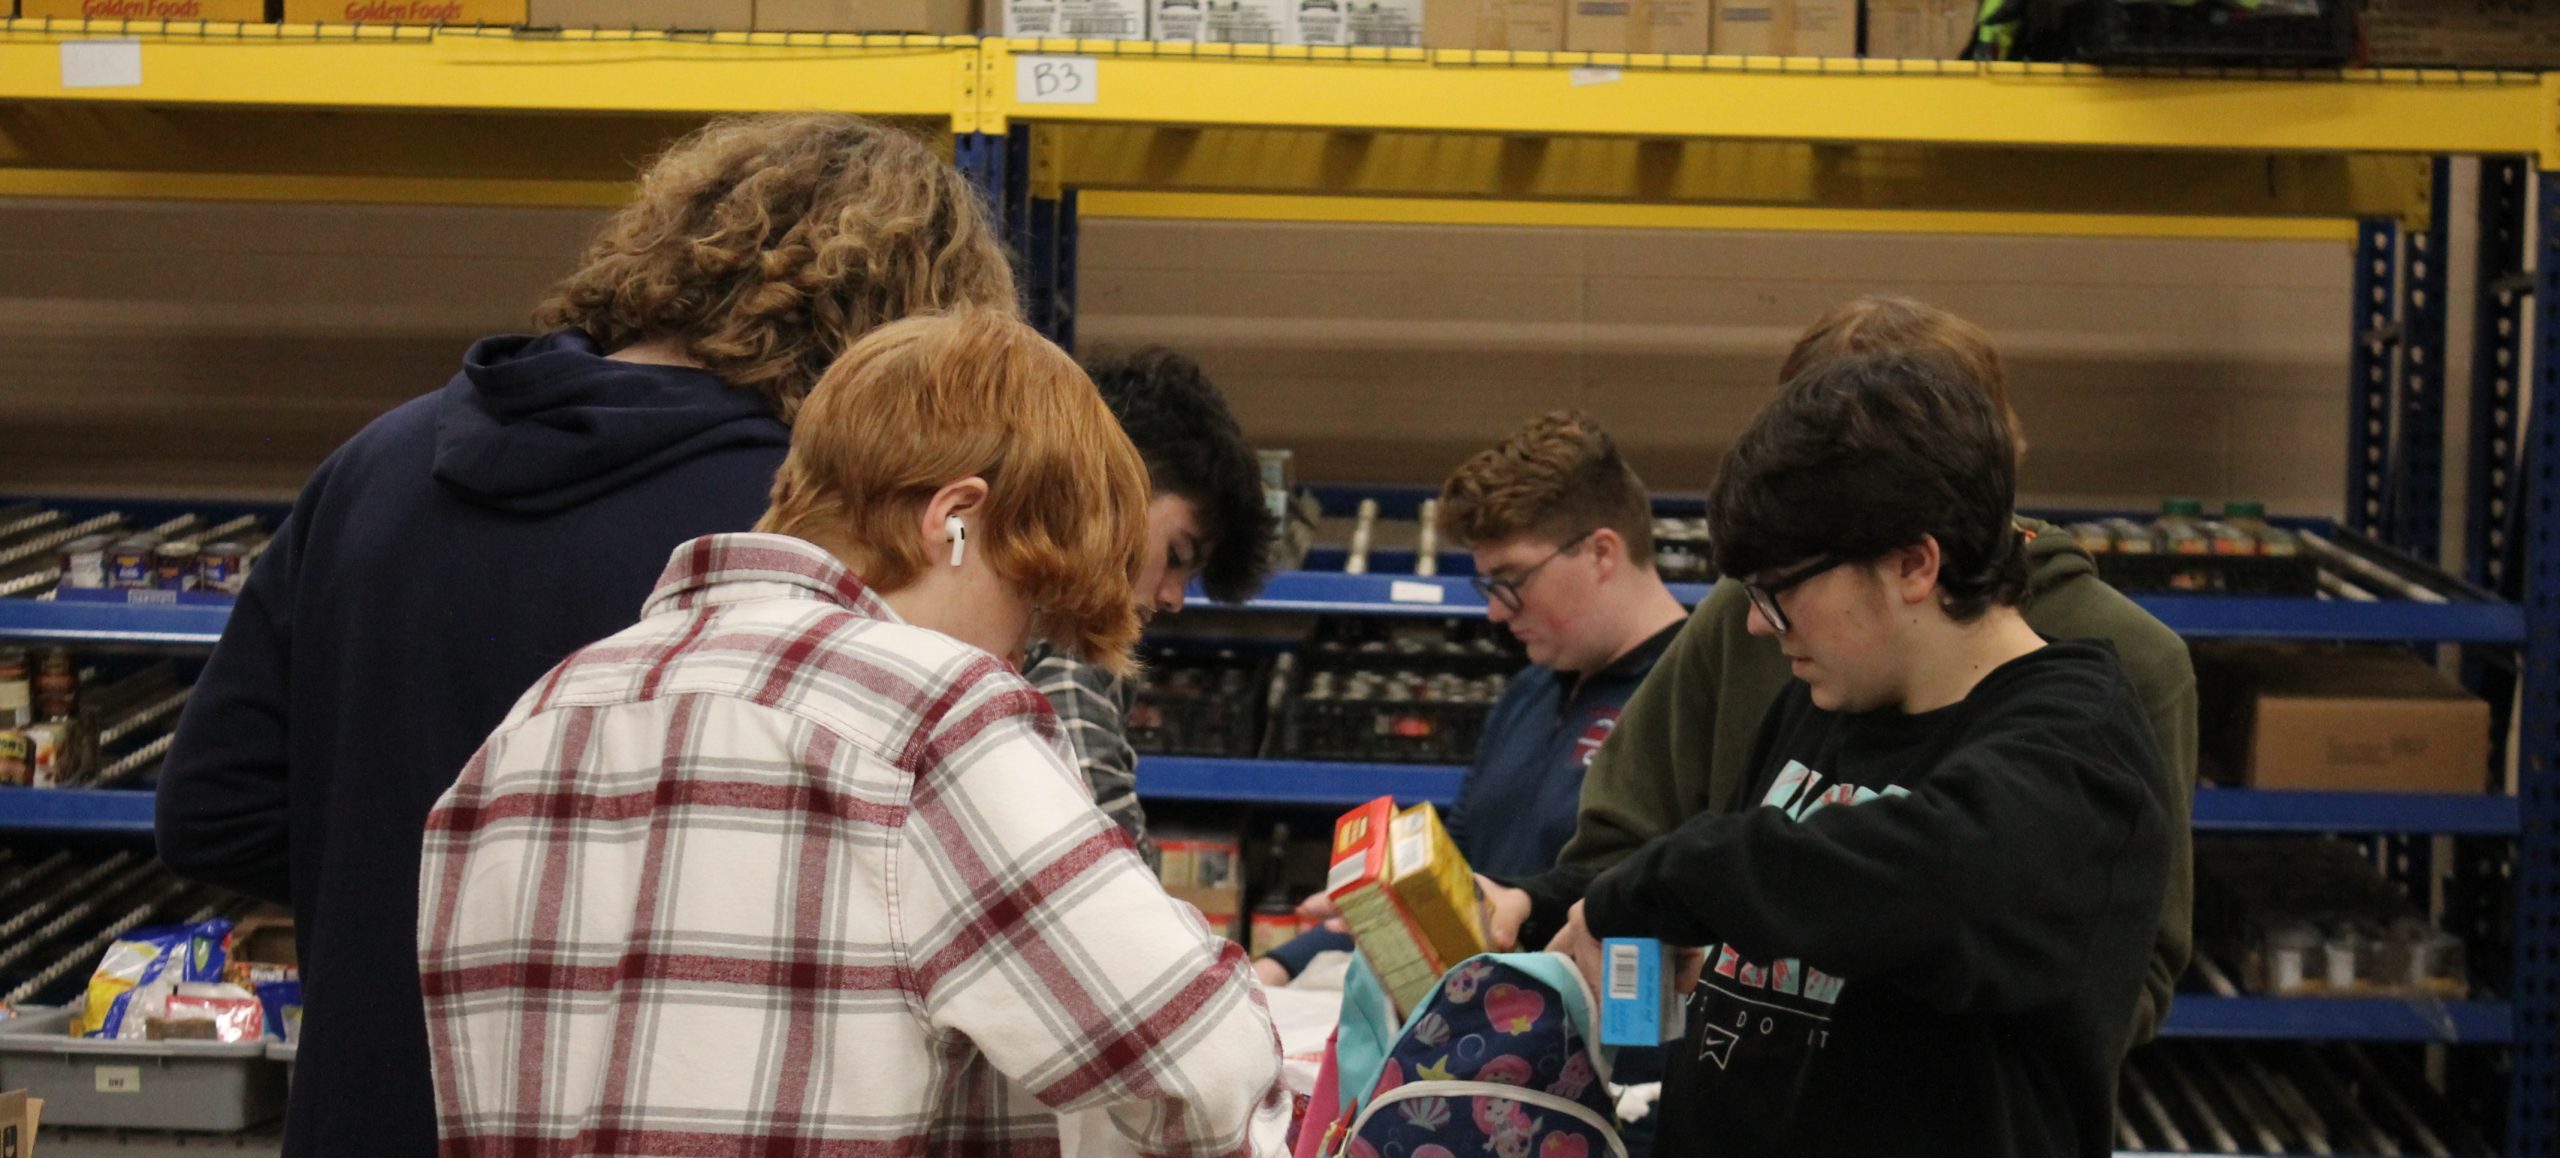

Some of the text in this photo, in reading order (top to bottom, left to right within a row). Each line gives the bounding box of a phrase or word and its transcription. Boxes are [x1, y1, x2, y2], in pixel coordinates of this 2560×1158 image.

[82, 0, 199, 18] Golden Foods
[344, 0, 463, 21] Golden Foods
[1034, 62, 1082, 97] B3
[1736, 1010, 1774, 1035] DO
